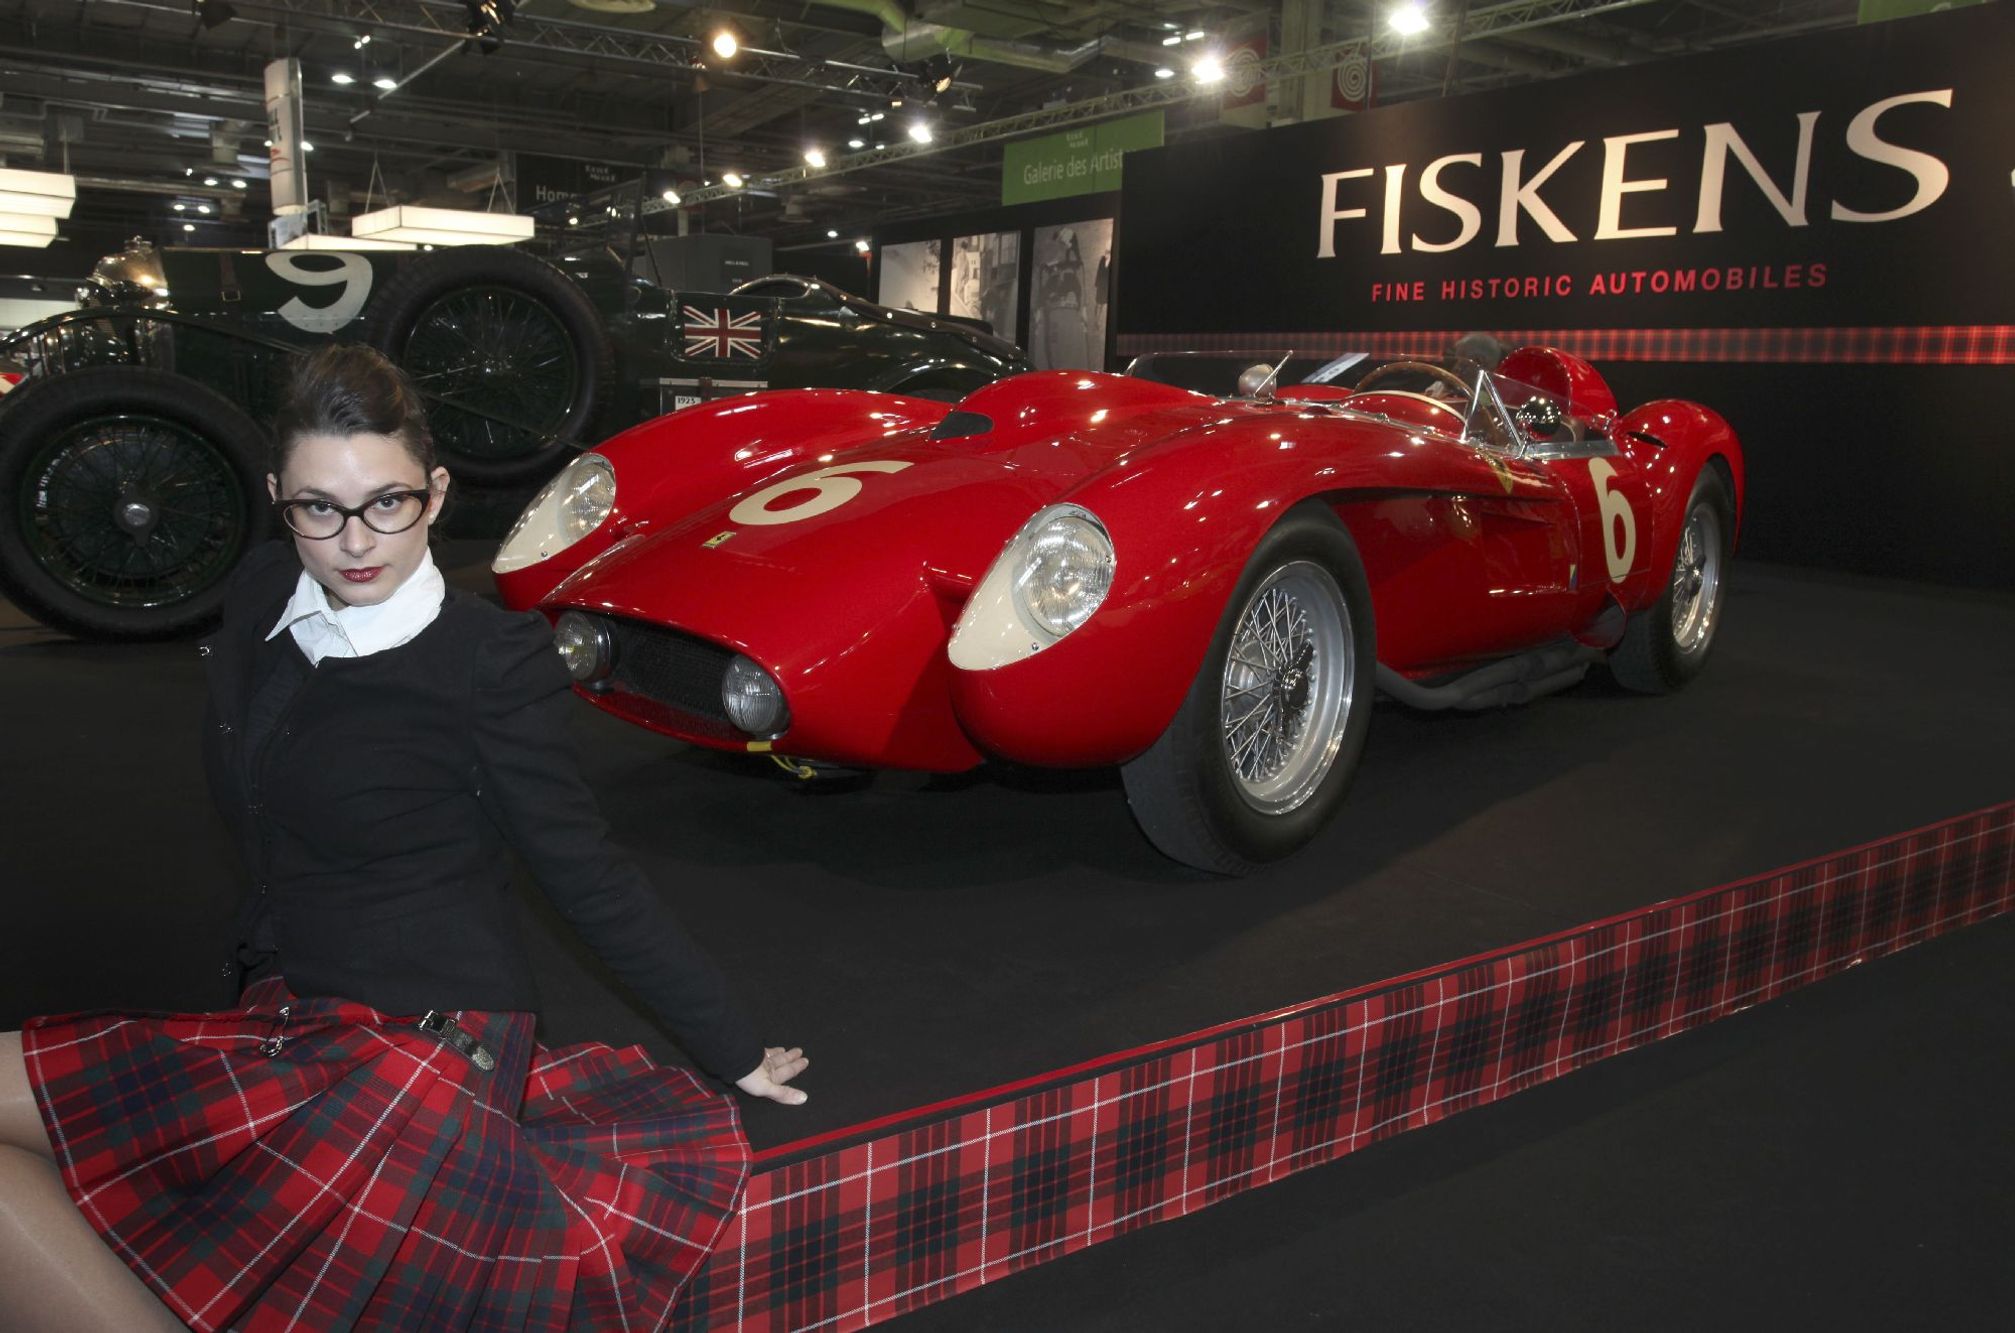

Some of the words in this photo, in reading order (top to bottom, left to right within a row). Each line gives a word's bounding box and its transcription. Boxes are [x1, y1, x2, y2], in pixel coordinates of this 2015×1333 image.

[1024, 159, 1063, 184] Galerie
[1066, 156, 1087, 177] des
[1090, 148, 1136, 174] Artist
[1317, 88, 1953, 258] FISKENS
[265, 251, 373, 334] 9
[1372, 281, 1424, 301] FINE
[1442, 275, 1572, 299] HISTORIC
[1589, 264, 1828, 296] AUTOMOBILES
[729, 460, 915, 525] 6
[1588, 457, 1636, 583] 6
